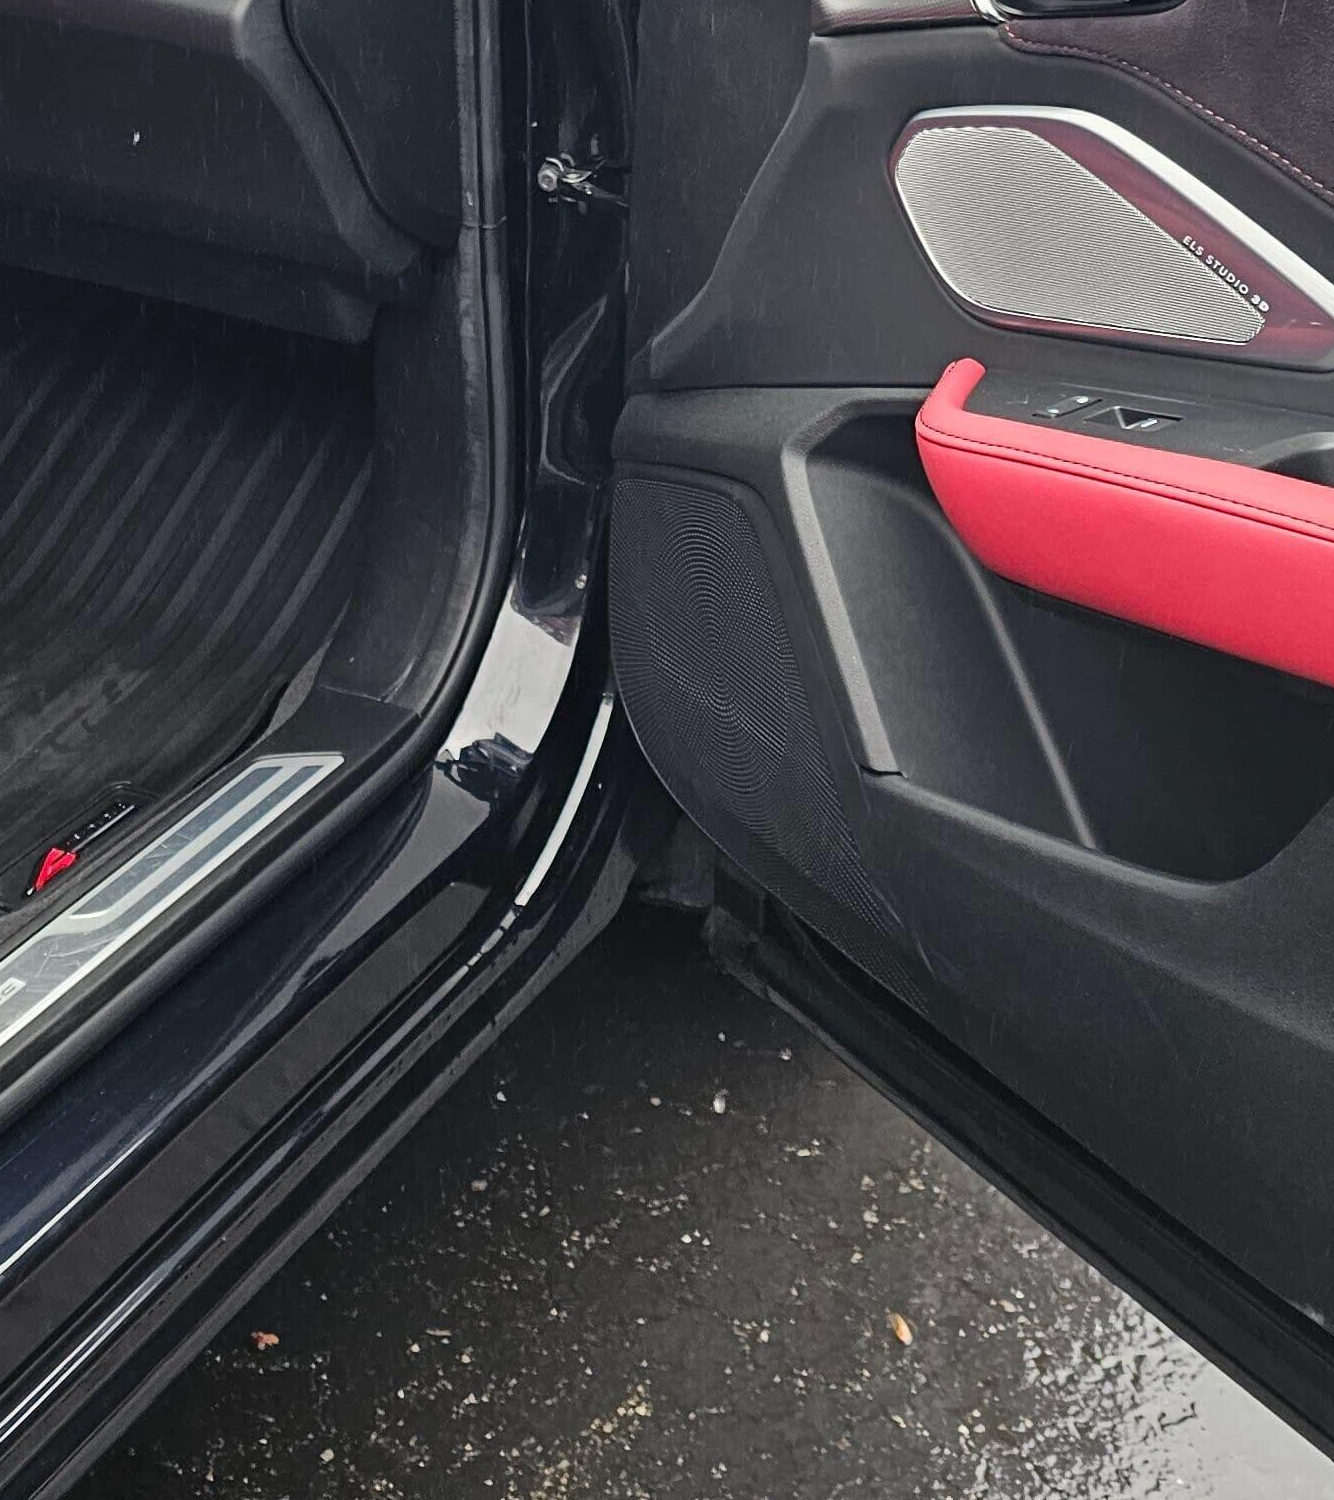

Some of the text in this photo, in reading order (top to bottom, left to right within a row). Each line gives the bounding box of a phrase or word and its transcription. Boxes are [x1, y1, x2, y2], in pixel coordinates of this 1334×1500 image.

[1181, 234, 1270, 313] ELS STUDIO 3D
